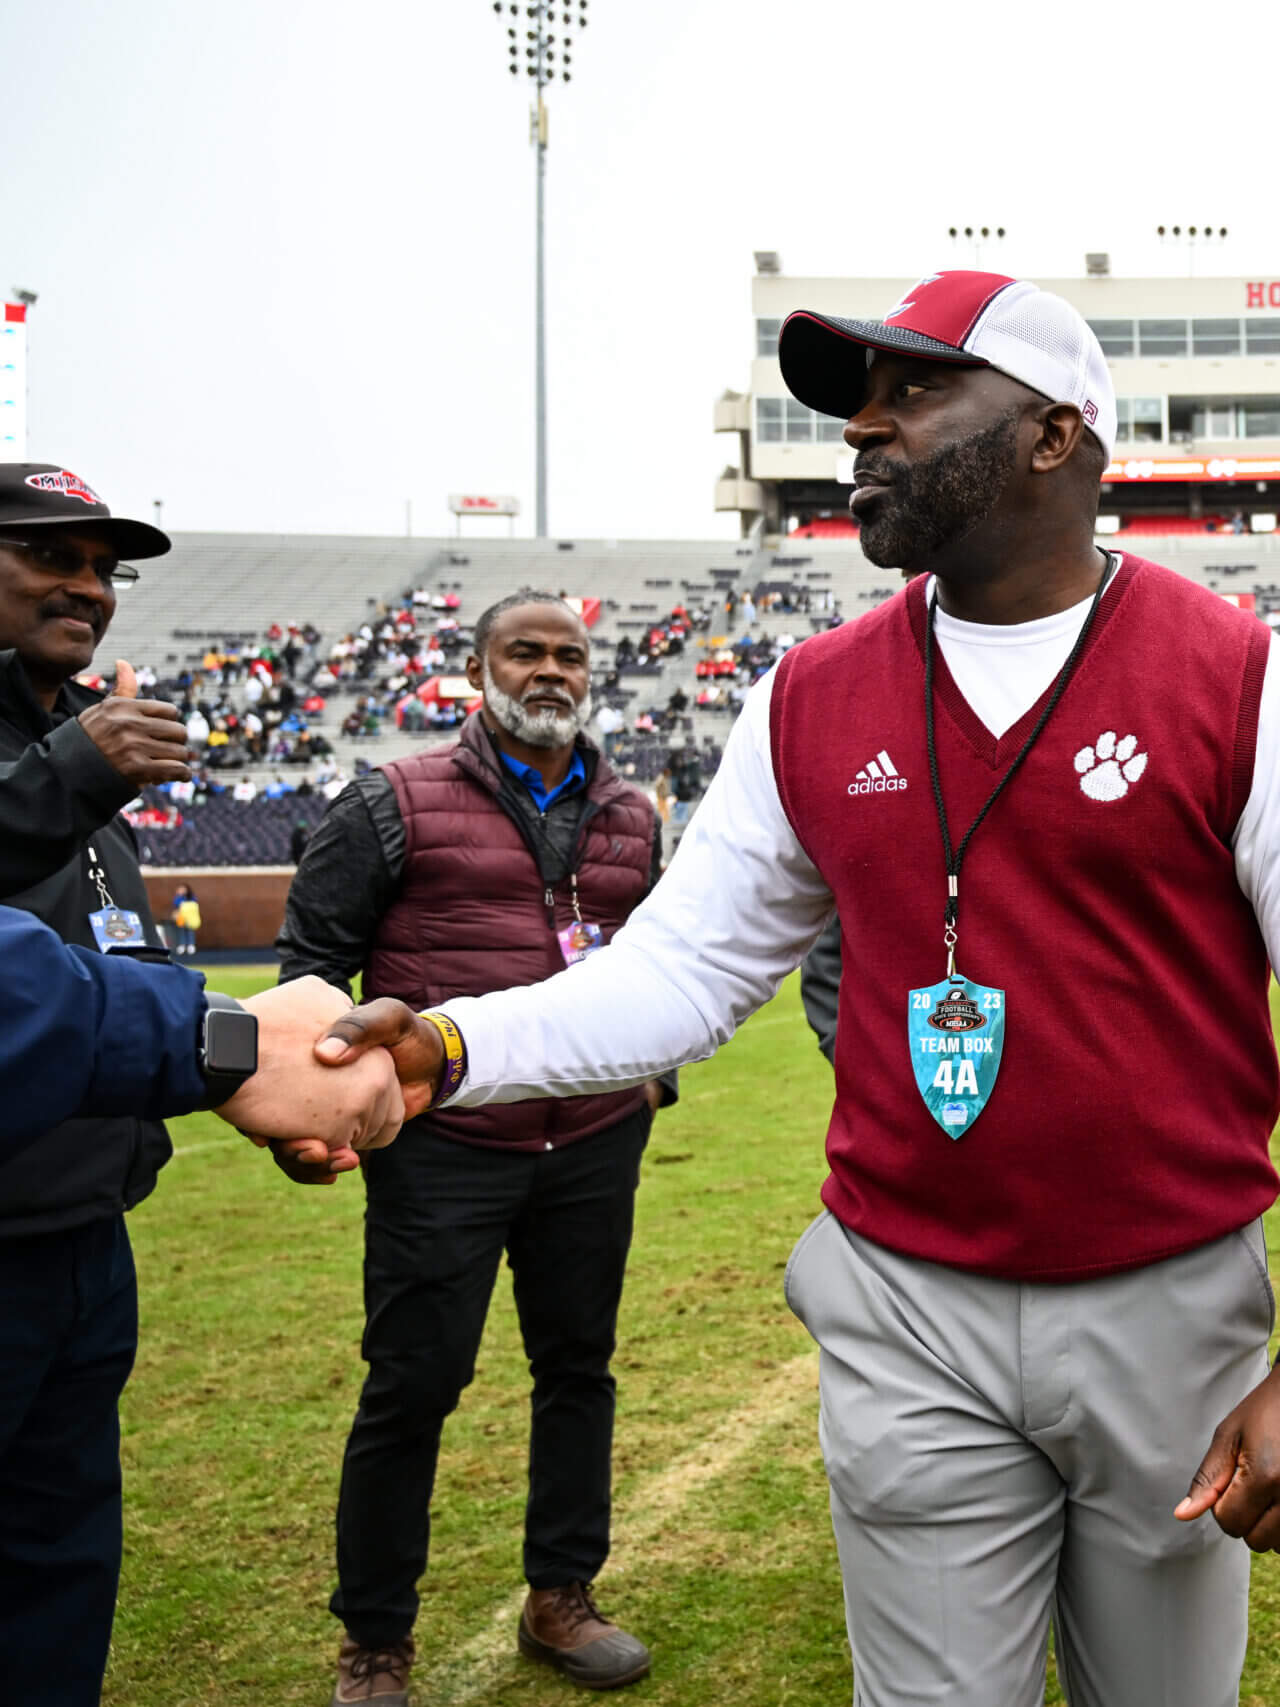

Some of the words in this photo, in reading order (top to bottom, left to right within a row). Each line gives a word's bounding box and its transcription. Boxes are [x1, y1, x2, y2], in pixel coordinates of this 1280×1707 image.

[847, 775, 908, 796] adidas
[912, 992, 931, 1009] 20
[983, 992, 1001, 1009] 23
[940, 1006, 974, 1014] FOOTBALL
[919, 1037, 960, 1053] TEAM
[963, 1037, 994, 1053] BOX
[932, 1059, 979, 1095] 4A
